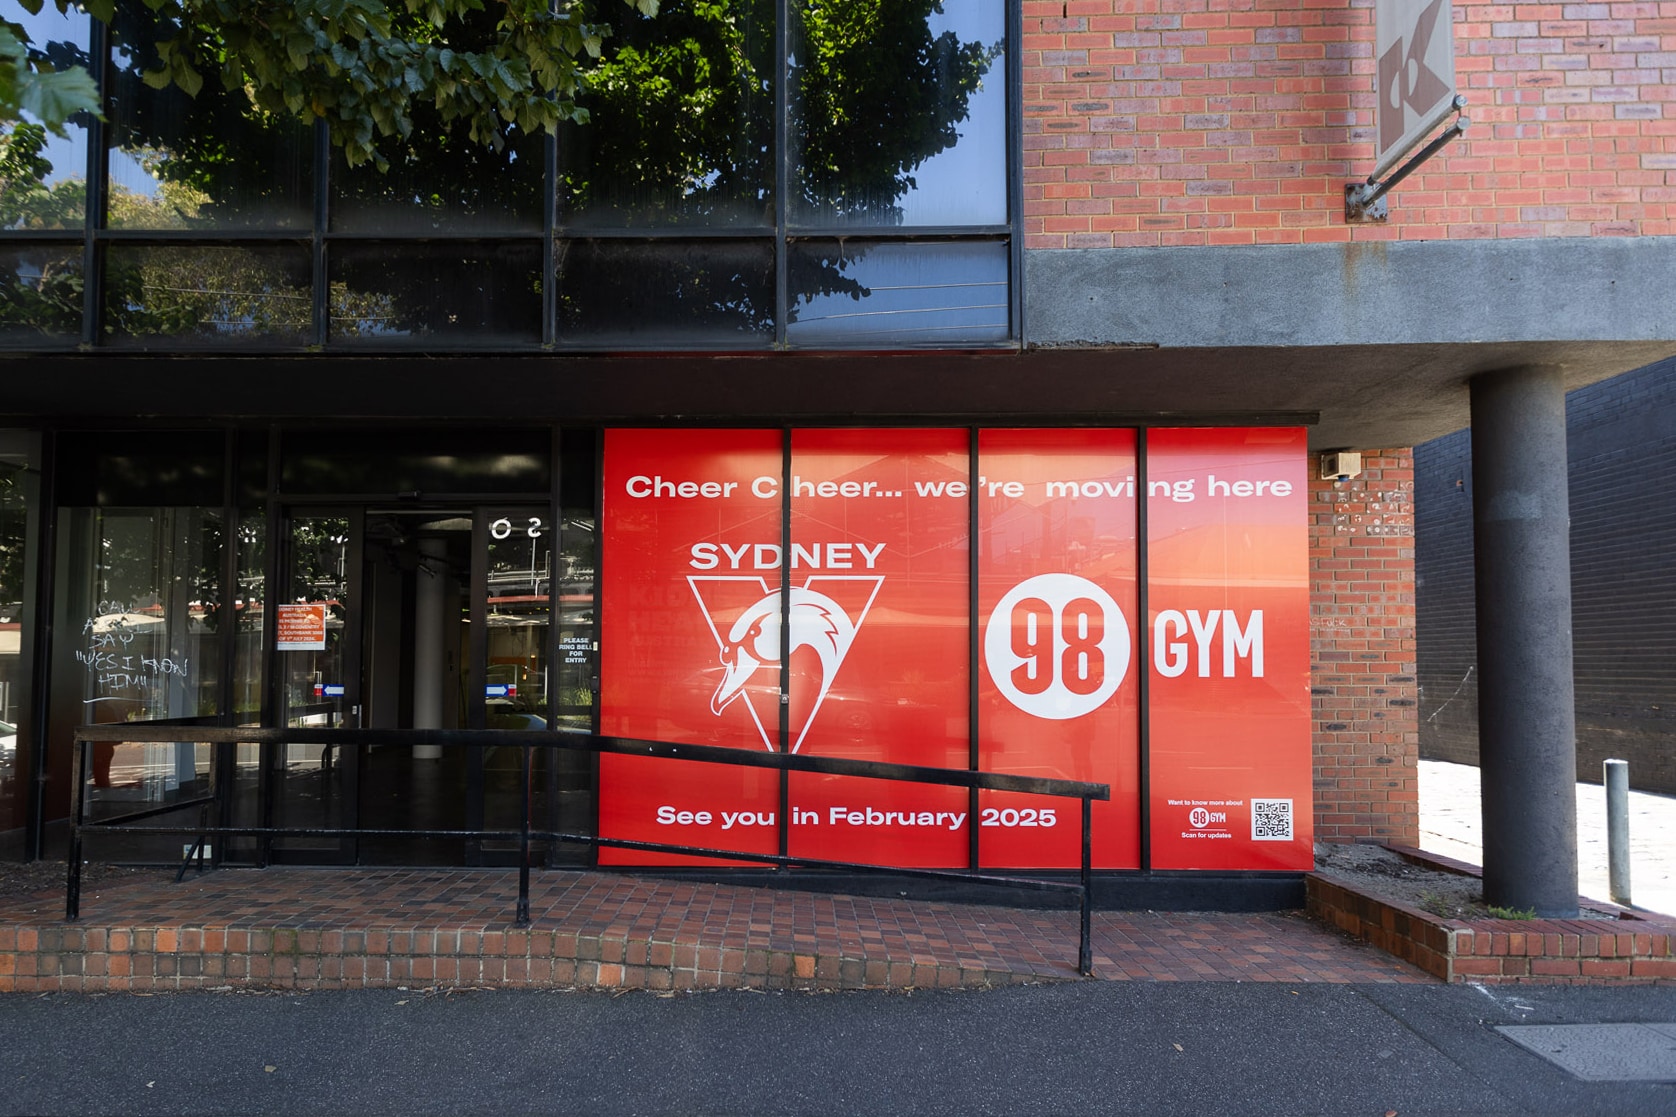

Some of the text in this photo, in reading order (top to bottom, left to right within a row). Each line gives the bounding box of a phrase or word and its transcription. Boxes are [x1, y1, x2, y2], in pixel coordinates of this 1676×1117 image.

[627, 475, 738, 498] Cheer
[1045, 475, 1196, 502] moving
[1207, 474, 1294, 498] here
[689, 542, 886, 569] SYDNEY
[88, 633, 134, 650] SAY
[1011, 597, 1264, 695] 98 GYM
[122, 655, 136, 671] I
[656, 806, 1057, 831] See you in February 2025
[1192, 810, 1226, 825] 98 GYM
[1207, 832, 1232, 840] updates
